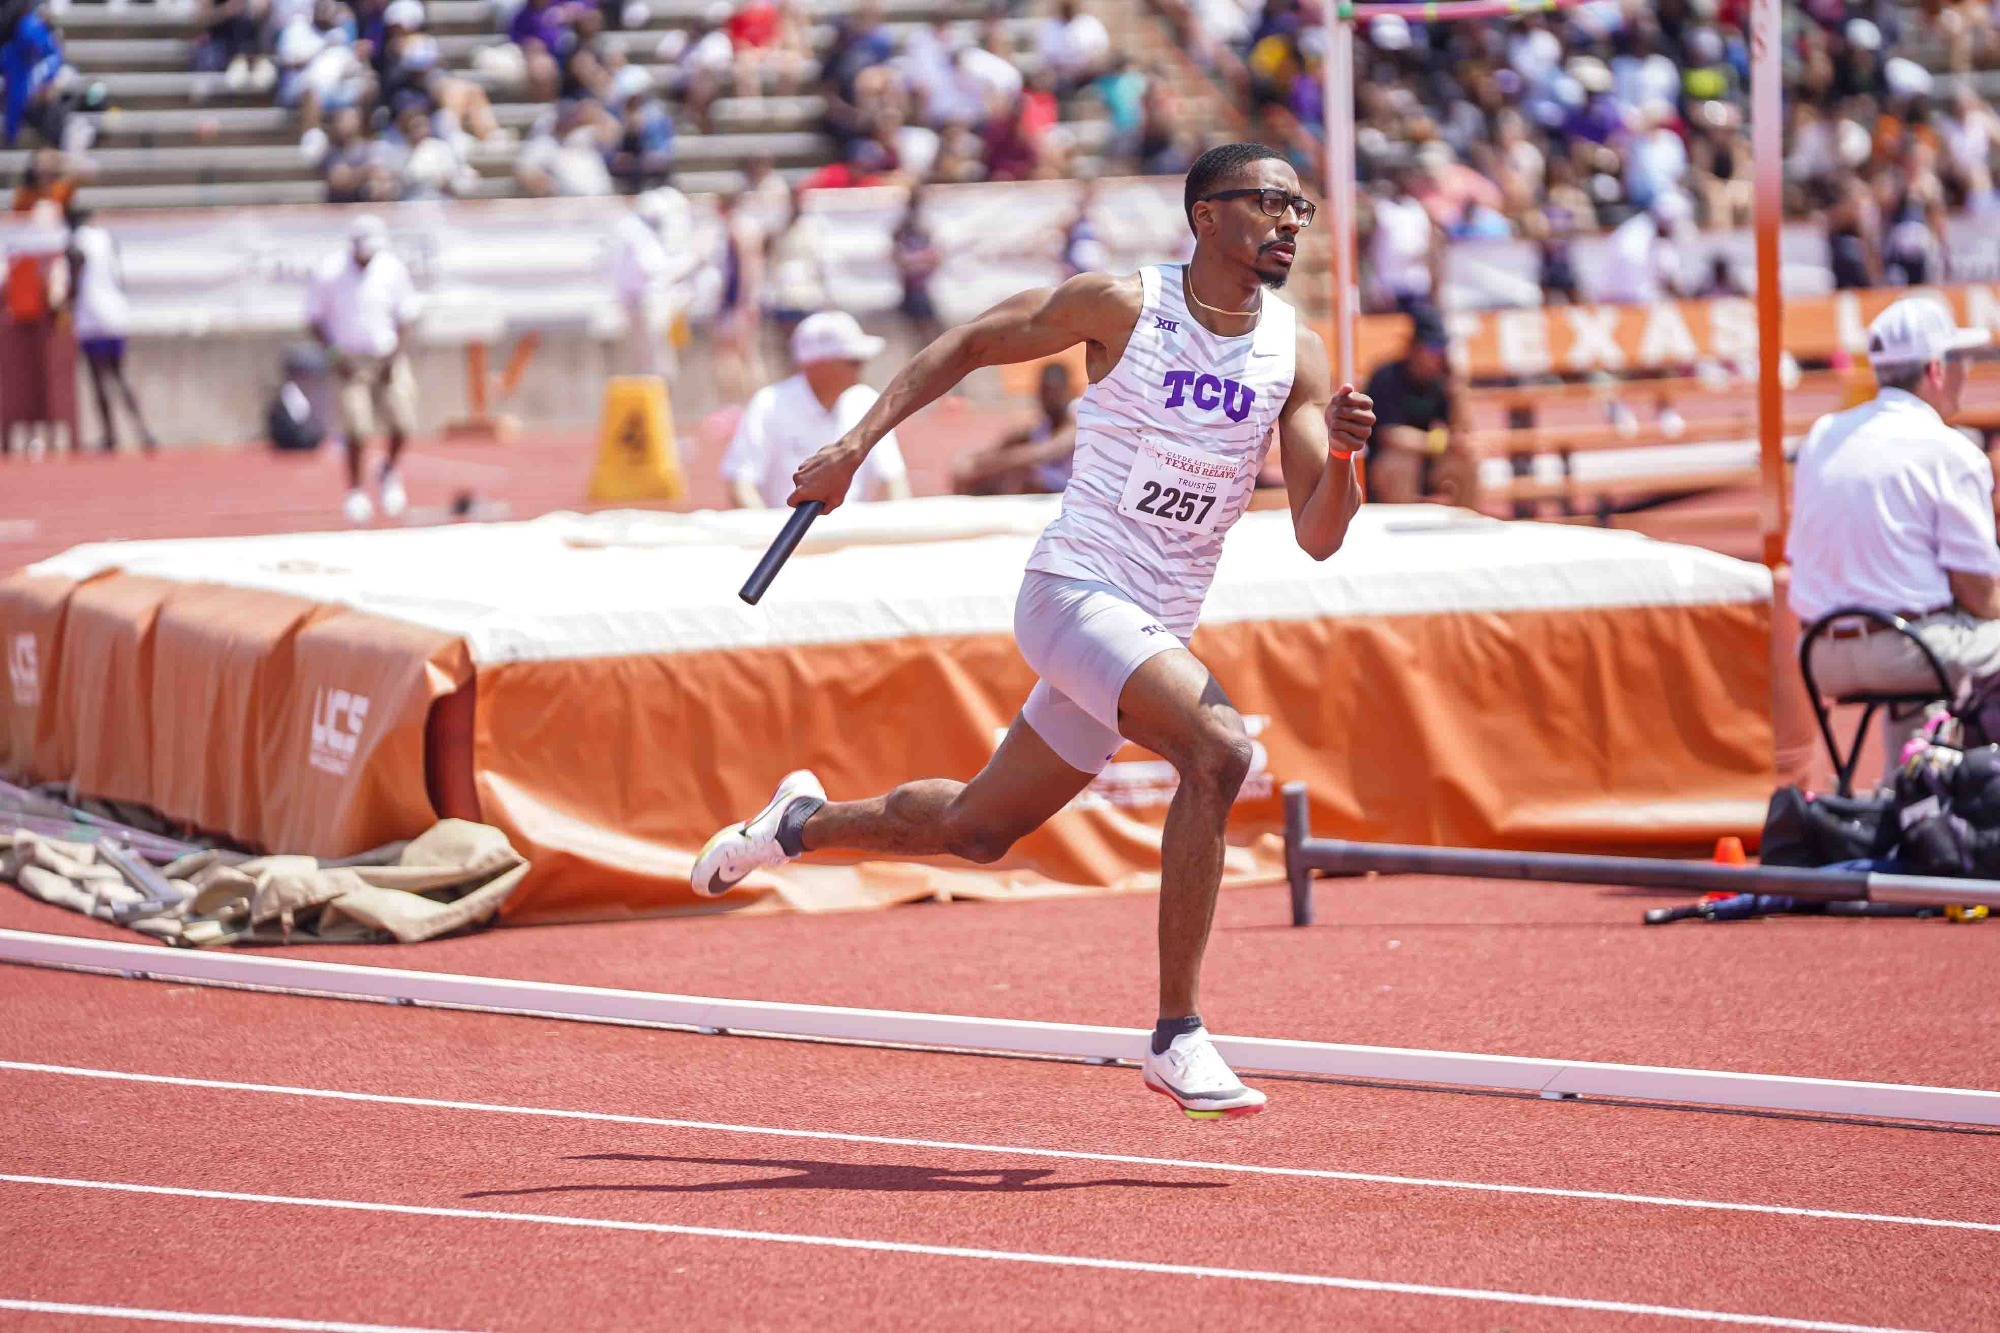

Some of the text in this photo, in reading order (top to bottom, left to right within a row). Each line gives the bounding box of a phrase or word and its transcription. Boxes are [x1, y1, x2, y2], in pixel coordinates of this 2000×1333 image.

[1154, 315, 1180, 334] XII
[1444, 300, 1759, 371] TEXAS
[1163, 370, 1256, 423] TCU
[1165, 456, 1201, 475] TEXAS
[1201, 467, 1236, 480] RELAYS
[1166, 451, 1238, 472] CLYDE LITTLEFIELD
[1178, 477, 1206, 491] TRUIST
[1135, 480, 1217, 525] 2257
[311, 686, 369, 753] UCS
